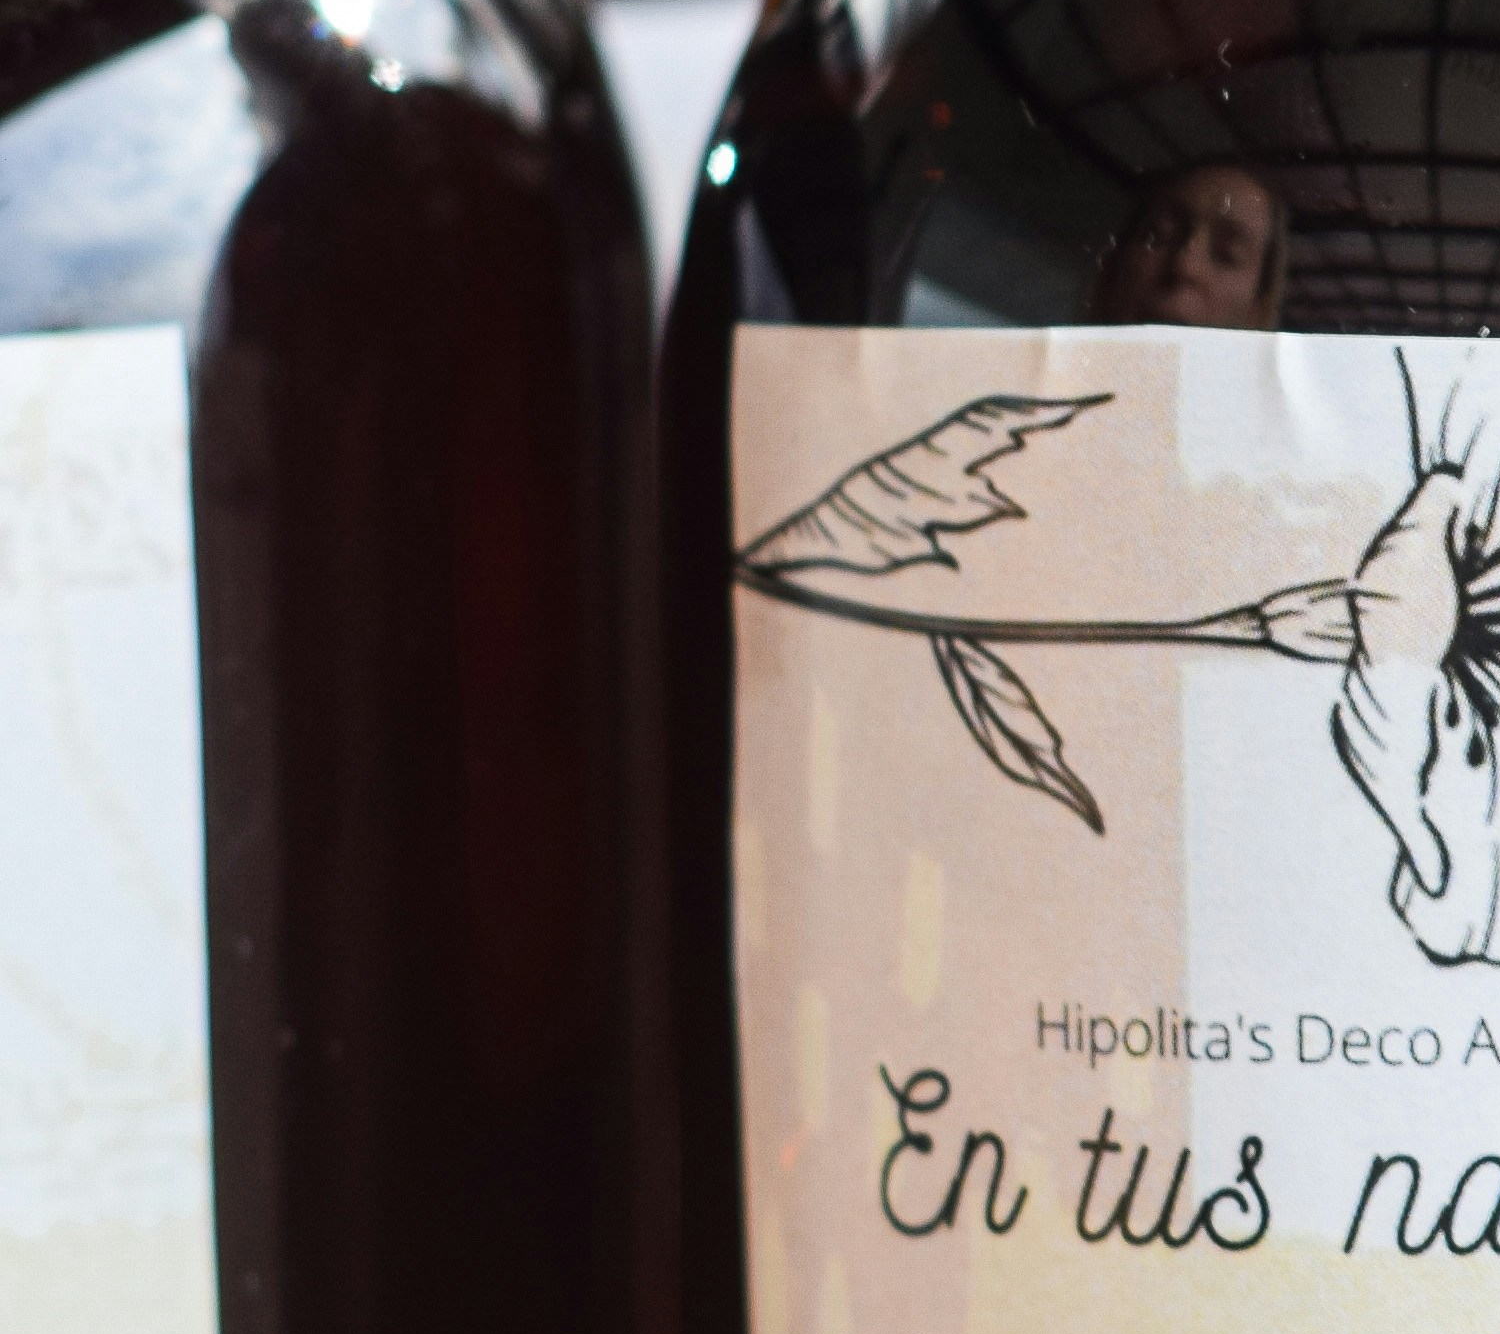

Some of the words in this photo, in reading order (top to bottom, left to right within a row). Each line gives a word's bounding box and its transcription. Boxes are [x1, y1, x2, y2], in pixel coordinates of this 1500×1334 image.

[1035, 1002, 1276, 1071] Hipolita's
[1295, 1012, 1444, 1068] Deco
[878, 1064, 1030, 1240] En
[1075, 1107, 1272, 1254] tus
